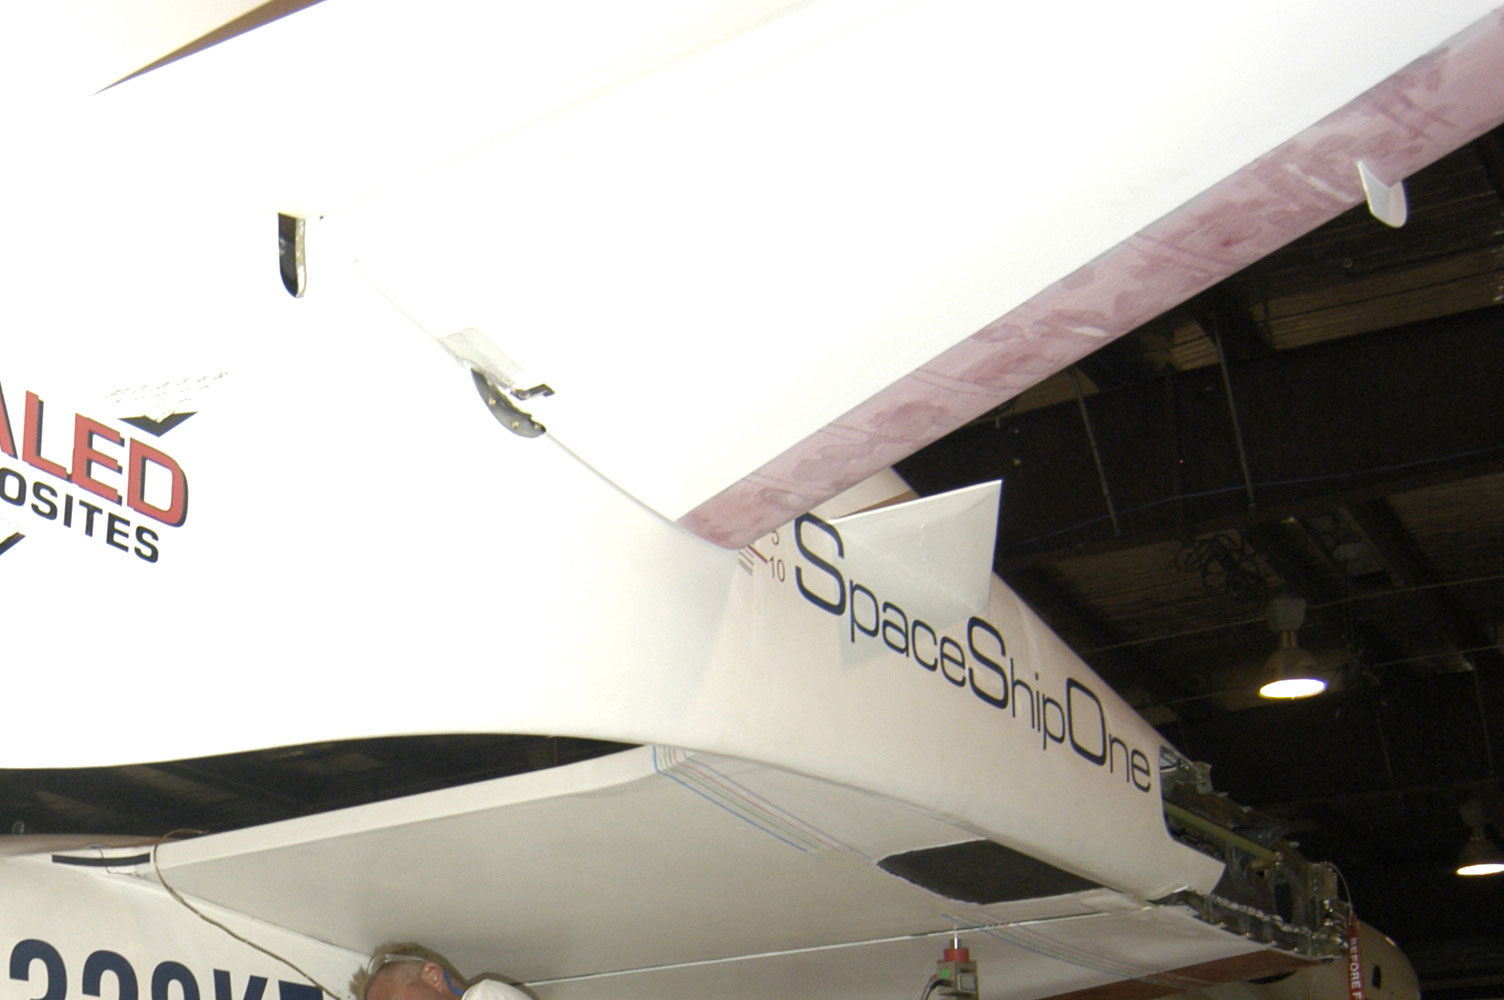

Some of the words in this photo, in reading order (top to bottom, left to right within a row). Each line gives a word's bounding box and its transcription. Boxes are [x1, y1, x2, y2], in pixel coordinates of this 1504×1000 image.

[769, 555, 786, 583] 10
[795, 512, 1152, 794] SpaceShipOne
[1349, 936, 1362, 989] BEFORE
